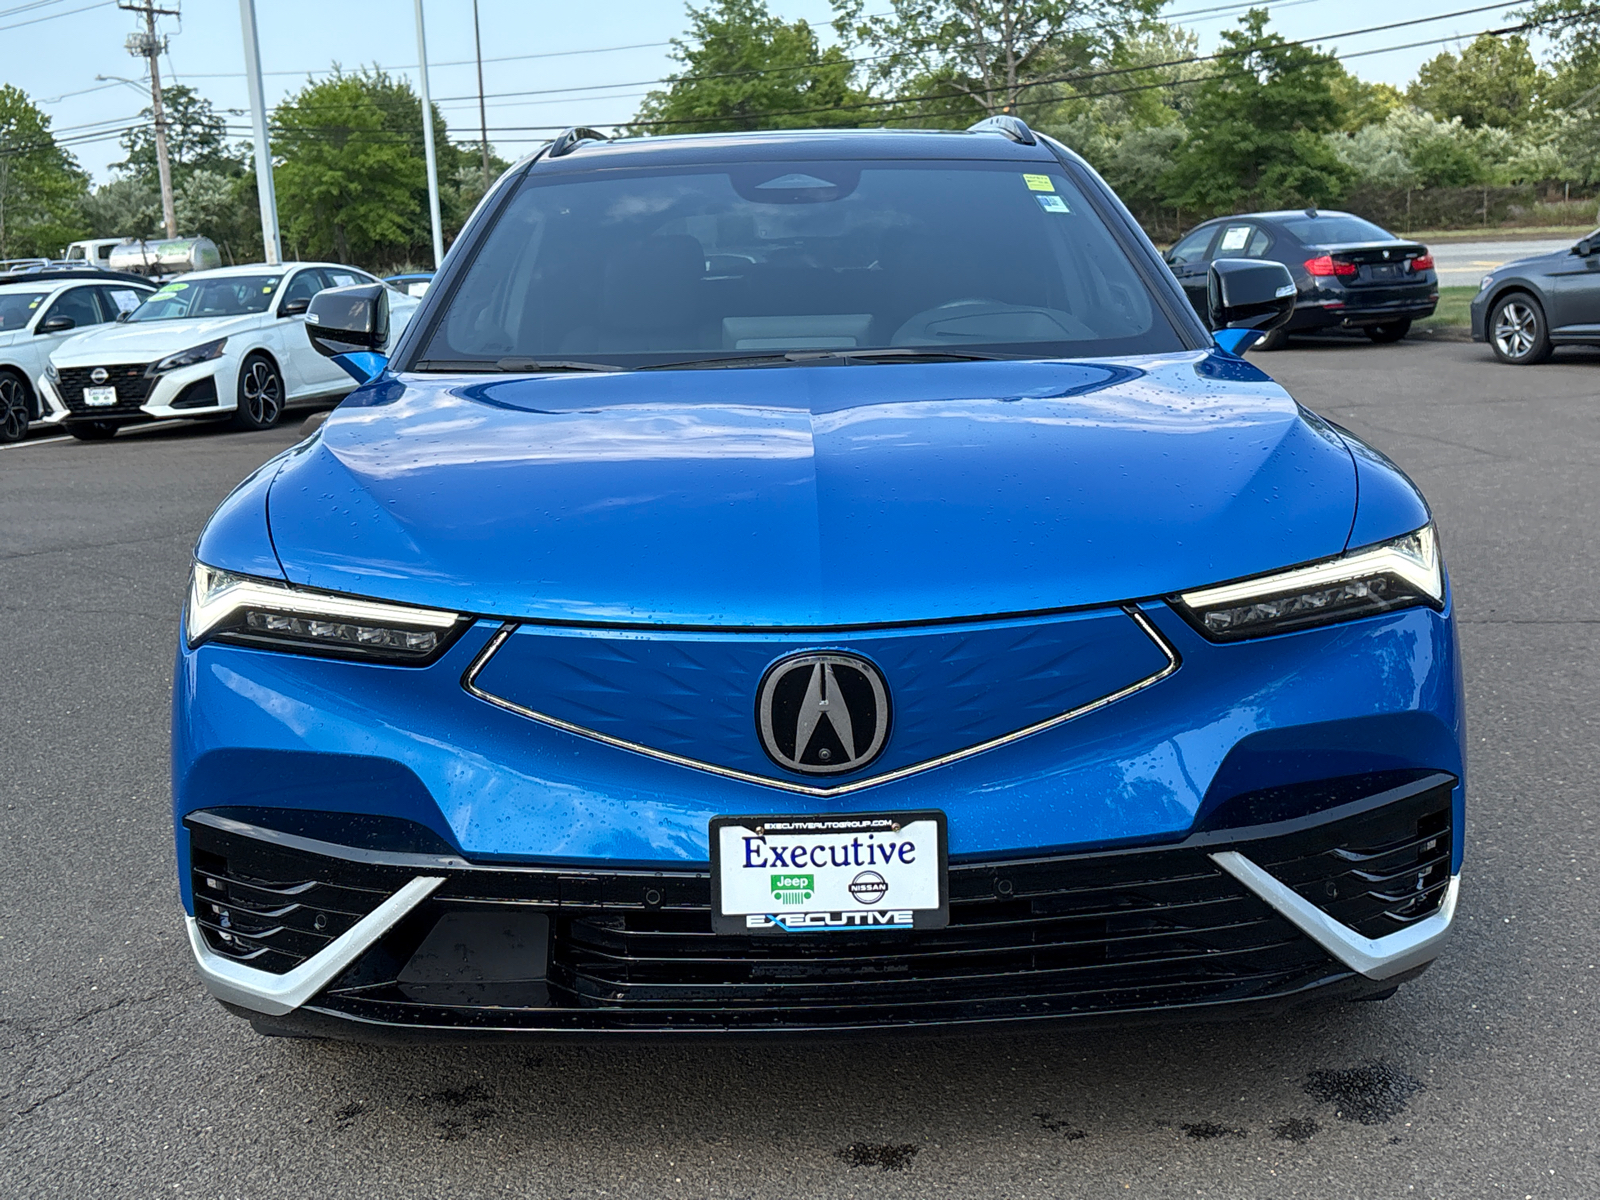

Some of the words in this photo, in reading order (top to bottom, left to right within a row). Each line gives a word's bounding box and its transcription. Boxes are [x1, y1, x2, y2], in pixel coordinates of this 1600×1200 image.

[764, 820, 892, 830] EXECUTIVEAUTOGROUP.COM
[742, 834, 916, 868] Executive
[776, 876, 809, 889] Jeep
[850, 884, 886, 892] NISSAN
[746, 911, 914, 928] EXECUTIVE
